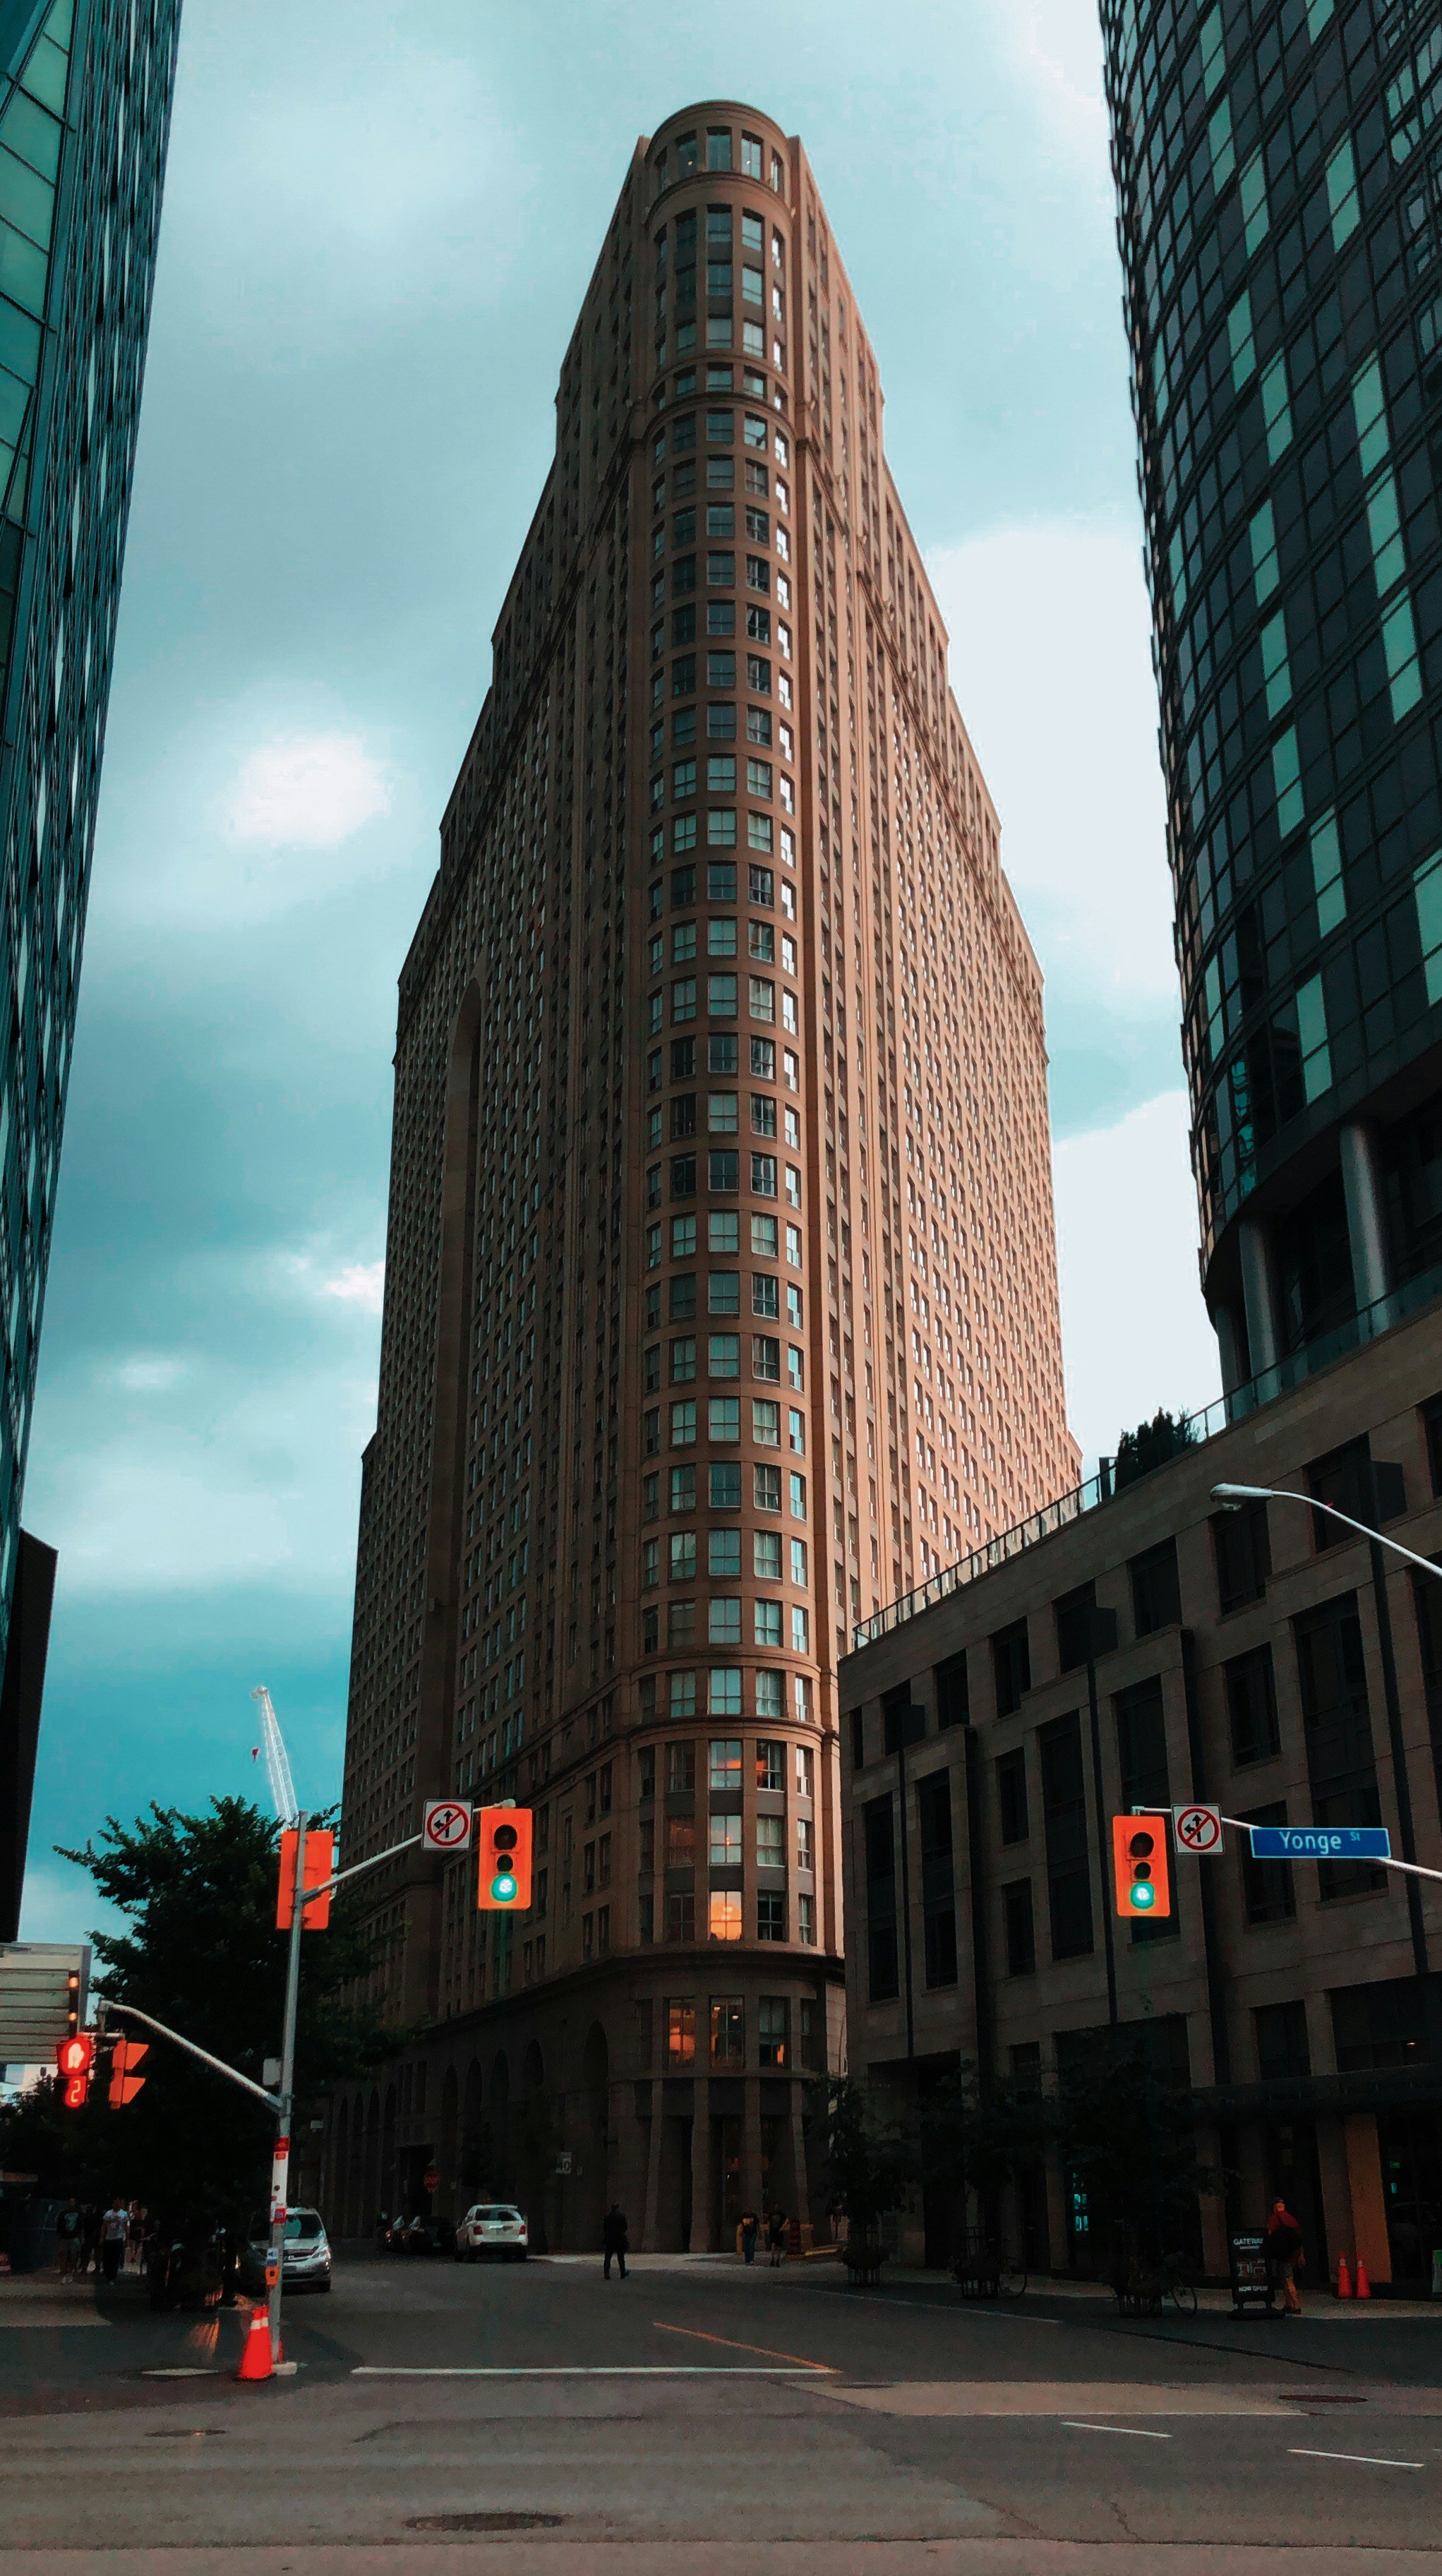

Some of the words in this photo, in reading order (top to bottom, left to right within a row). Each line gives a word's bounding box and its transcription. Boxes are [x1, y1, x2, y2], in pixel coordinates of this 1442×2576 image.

[1279, 1831, 1342, 1855] Yonge
[1350, 1831, 1362, 1841] St
[71, 2080, 81, 2102] 2
